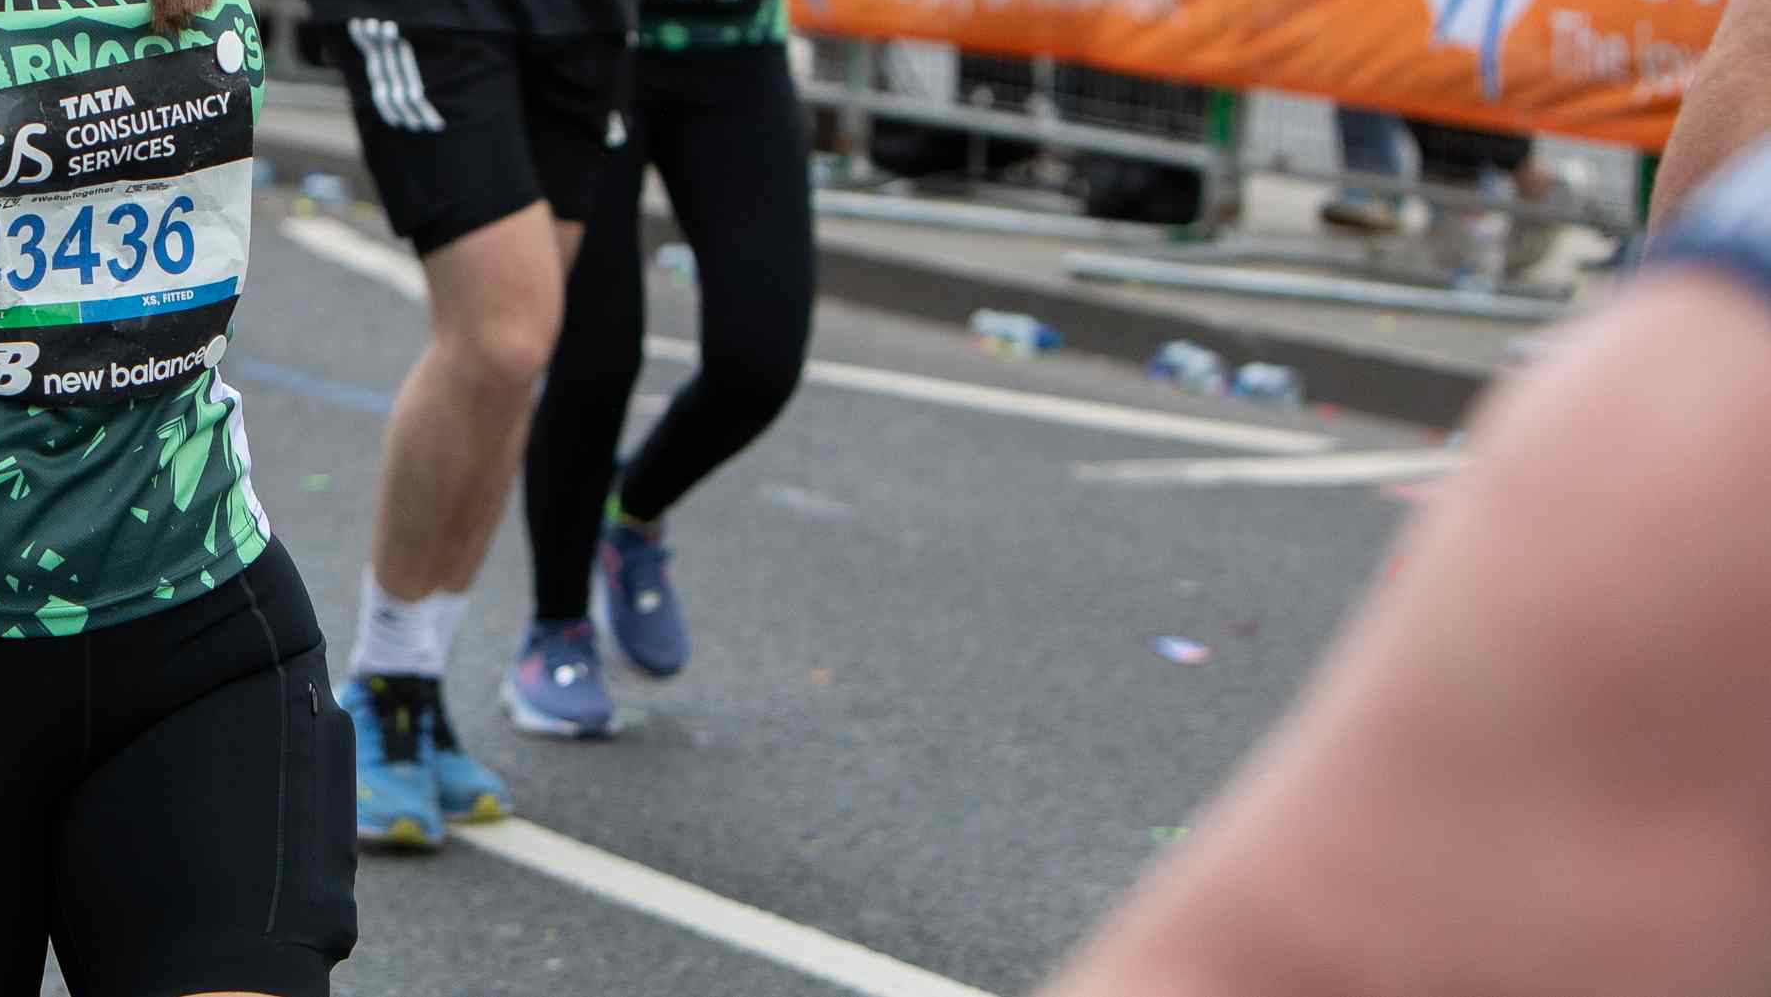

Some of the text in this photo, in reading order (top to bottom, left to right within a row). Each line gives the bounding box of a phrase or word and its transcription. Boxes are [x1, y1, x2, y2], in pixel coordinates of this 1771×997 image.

[59, 85, 136, 121] TATA
[65, 92, 231, 149] CONSULTANCY
[67, 134, 177, 177] SERVICES
[141, 289, 195, 307] XS, FITTED
[43, 370, 103, 395] new
[110, 344, 207, 389] balance
